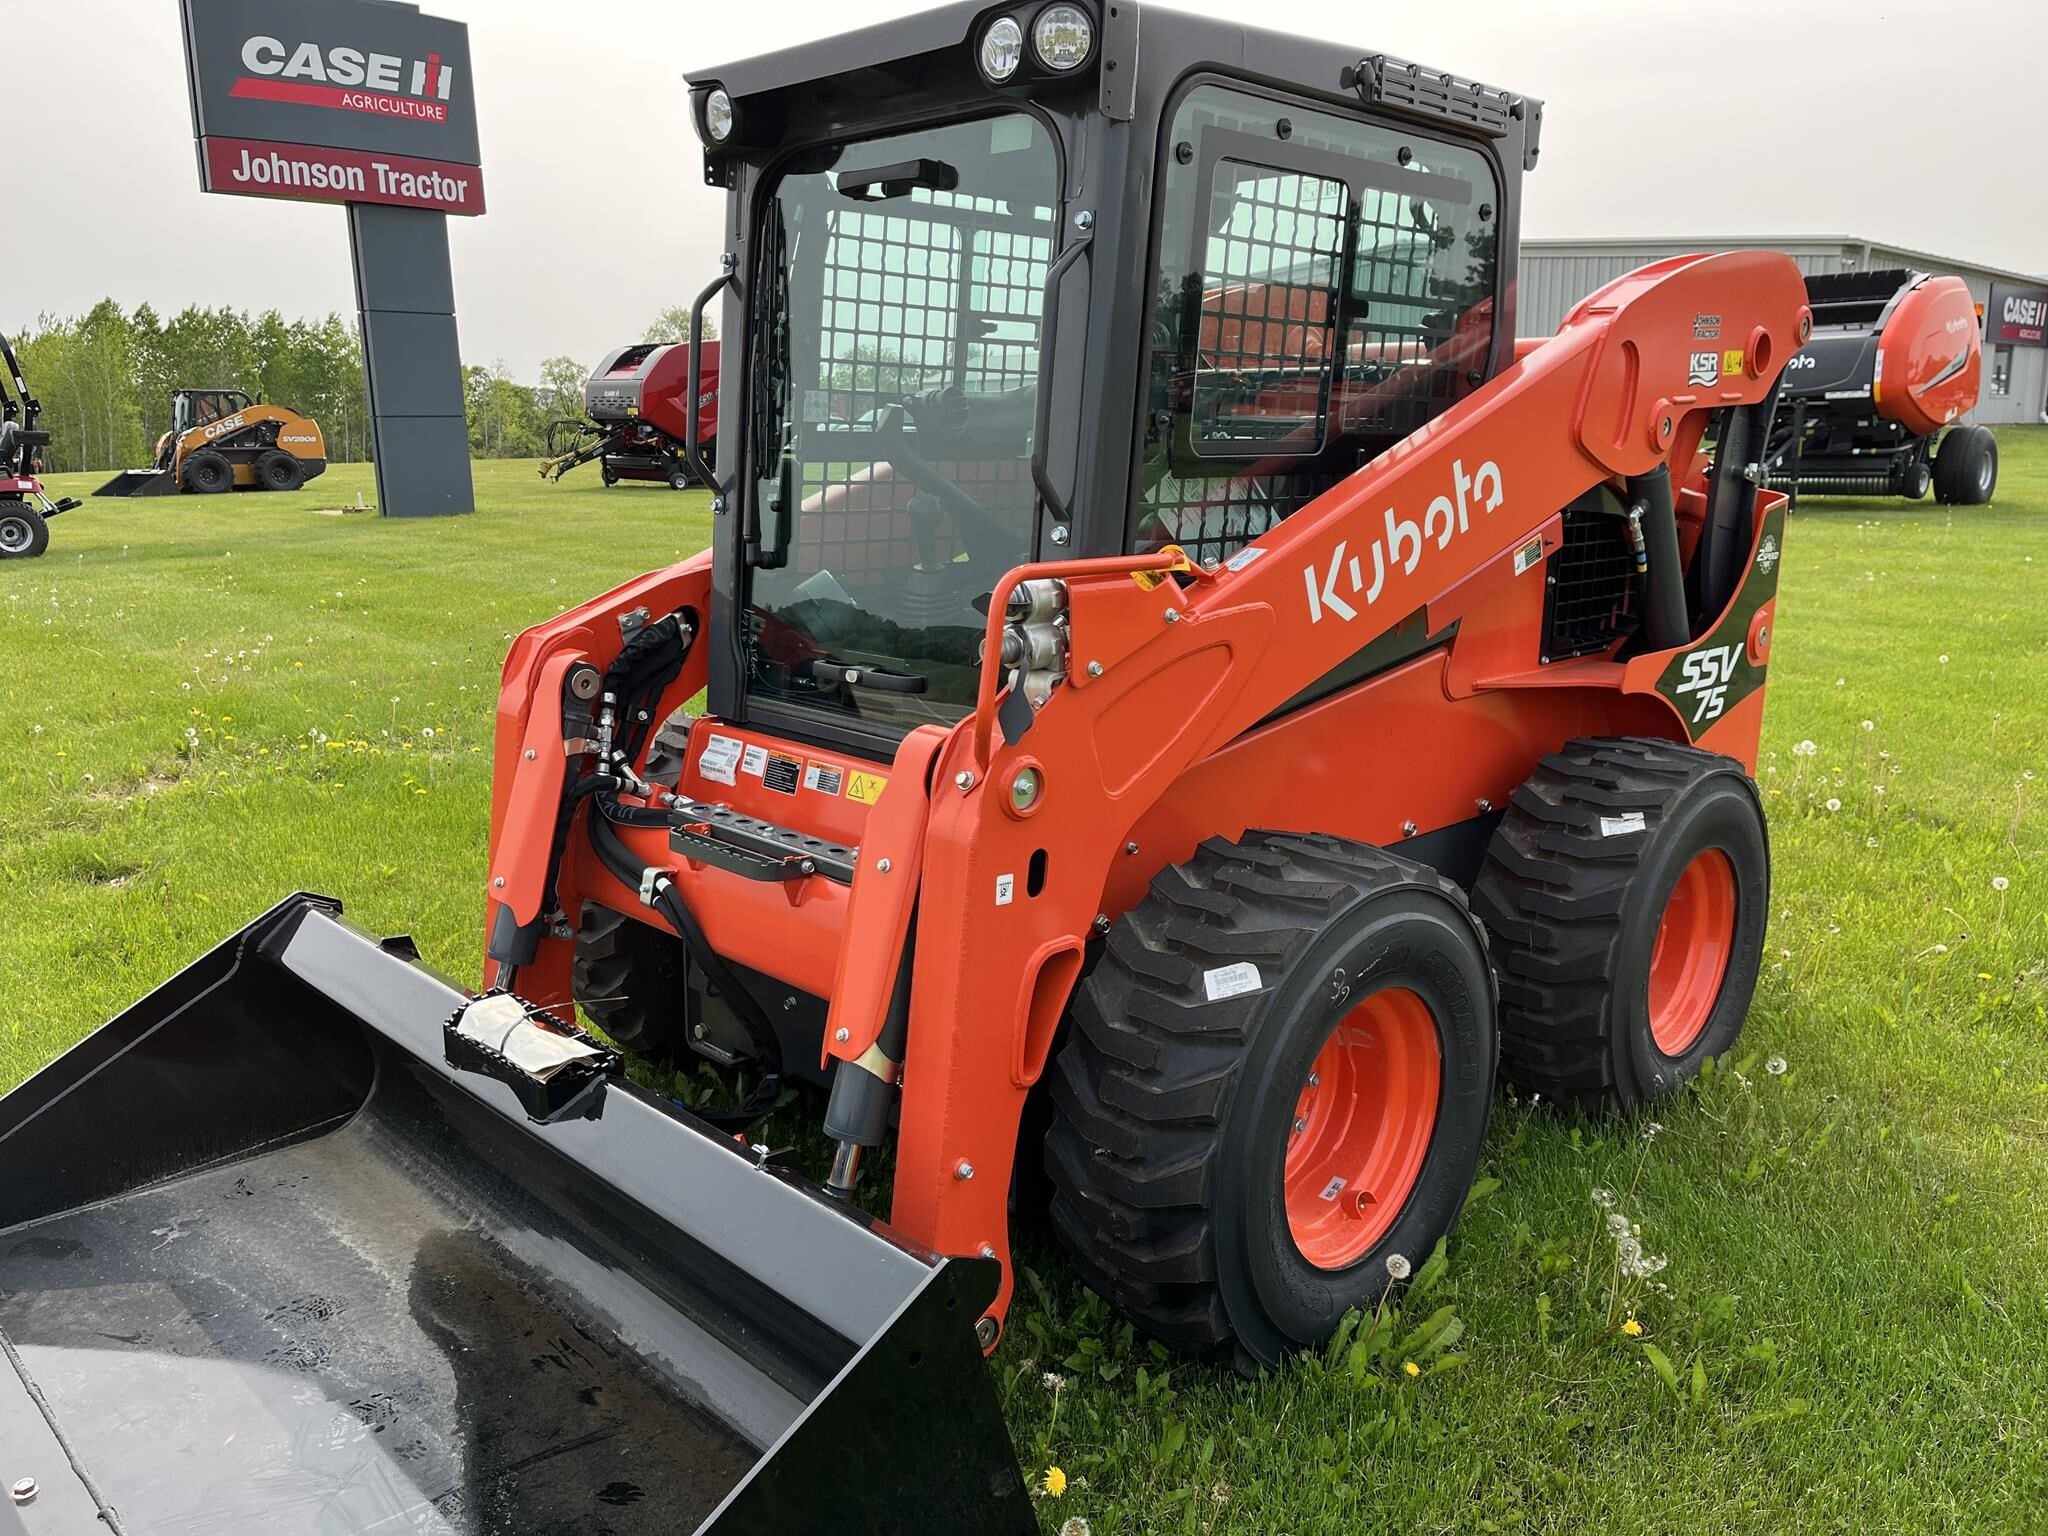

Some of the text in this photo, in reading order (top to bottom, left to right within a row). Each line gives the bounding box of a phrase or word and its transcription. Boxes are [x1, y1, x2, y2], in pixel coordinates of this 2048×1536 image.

[241, 35, 402, 92] CASE
[342, 93, 443, 120] AGRICULTURE
[232, 149, 468, 203] Johnson Tractor
[2003, 295, 2037, 325] CASE
[1788, 354, 1816, 369] ota
[204, 415, 244, 438] CASE
[1304, 458, 1504, 625] Kubota
[1675, 642, 1745, 694] SSV
[1691, 684, 1728, 724] 75
